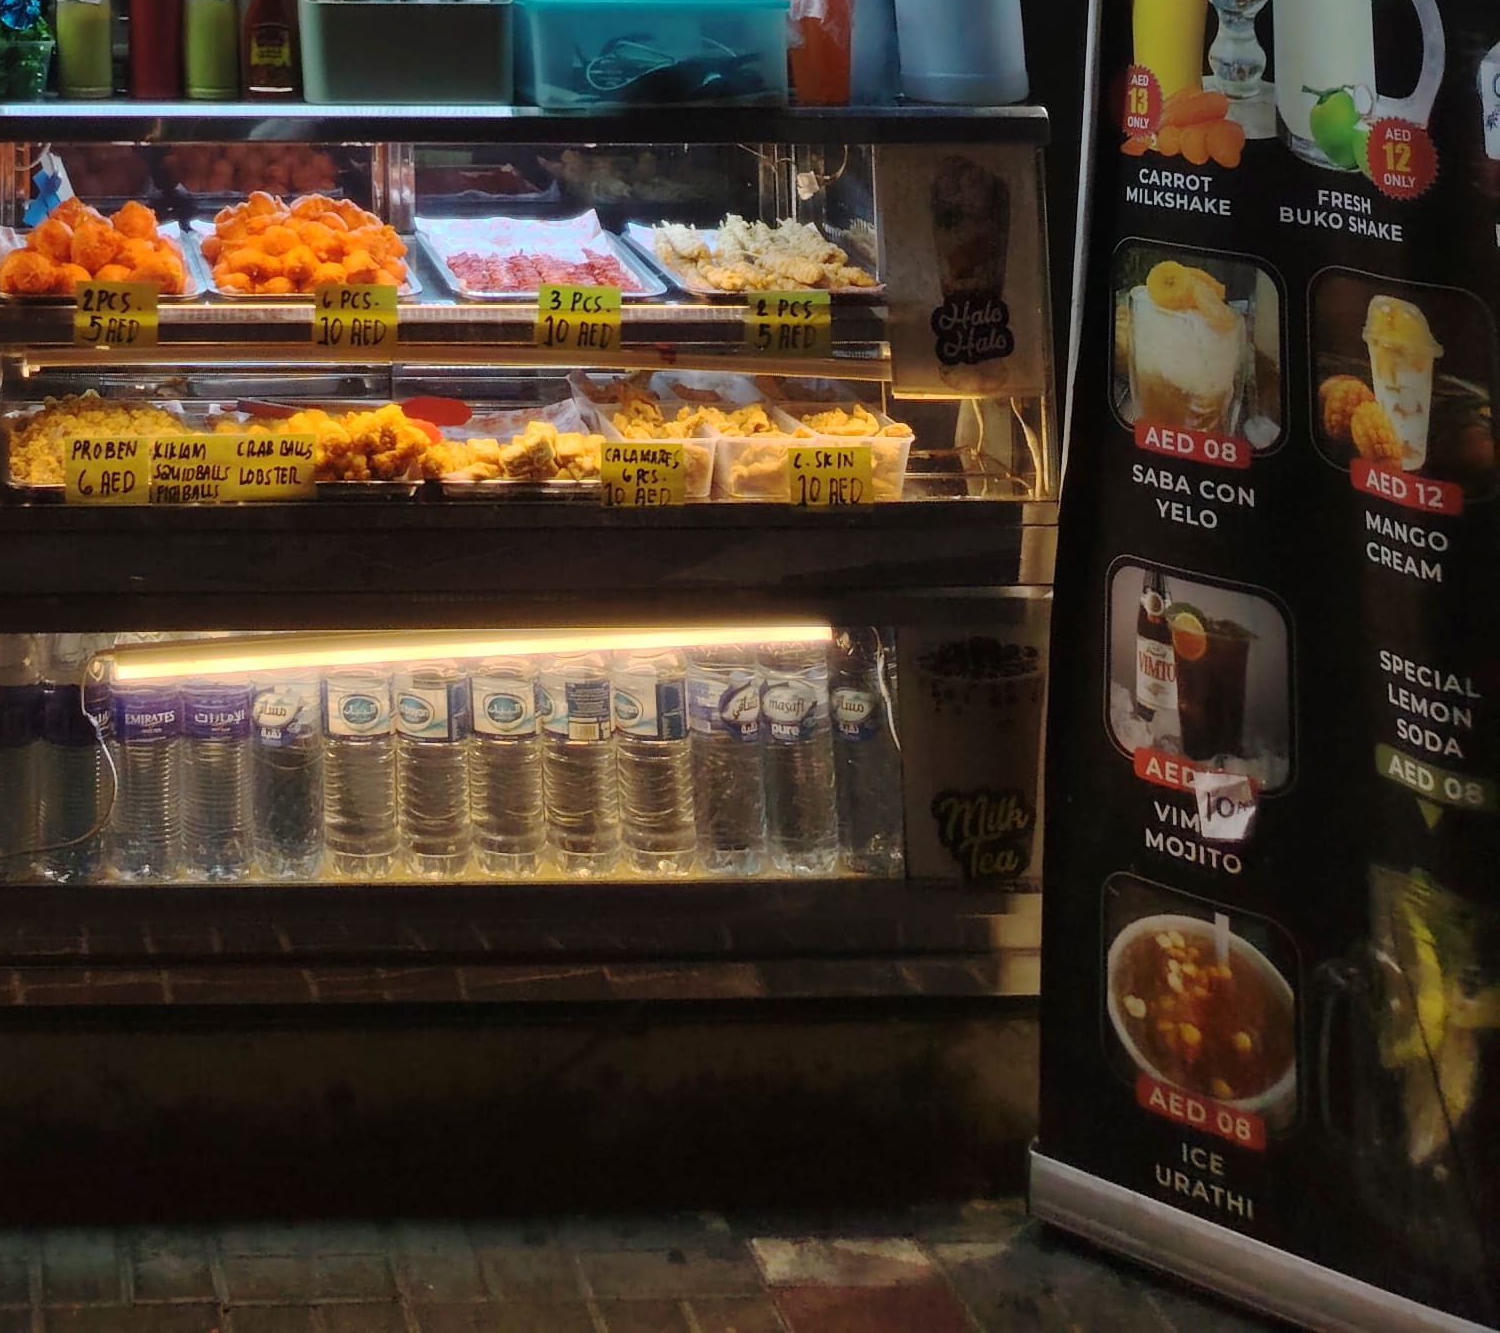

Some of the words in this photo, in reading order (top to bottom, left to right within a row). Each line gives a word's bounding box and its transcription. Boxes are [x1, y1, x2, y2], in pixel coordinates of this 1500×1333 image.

[1130, 74, 1149, 86] AED
[1128, 86, 1149, 115] 13
[1127, 115, 1150, 129] ONLY
[1384, 128, 1412, 143] AED
[1383, 144, 1412, 173] 12
[1138, 167, 1213, 194] CARROT
[1383, 173, 1416, 189] ONLY
[1125, 186, 1232, 217] MILKSHAKE
[1317, 189, 1372, 216] FRESH
[1278, 206, 1344, 231] BUKO
[1347, 215, 1404, 243] SHAKE
[550, 290, 561, 311] 3
[777, 299, 813, 318] PCS
[86, 317, 102, 341] 5
[104, 317, 141, 343] AED
[317, 316, 344, 346] 10
[348, 315, 388, 347] AED
[542, 315, 570, 346] 10
[577, 321, 613, 348] AED
[756, 323, 772, 349] 5
[778, 323, 817, 349] AED
[71, 440, 137, 461] PROBEN
[814, 451, 854, 468] SKIN
[1143, 426, 1195, 455] AED
[1203, 432, 1238, 464] 08
[77, 469, 94, 496] 6
[99, 468, 136, 495] AED
[239, 465, 302, 486] LOBSTER
[797, 475, 821, 507] 10
[828, 476, 864, 506] AED
[1130, 463, 1192, 496] SABA
[1198, 479, 1256, 508] CON
[1364, 467, 1408, 500] AED
[1414, 481, 1444, 509] 12
[603, 482, 626, 507] 10
[634, 487, 672, 507] AED
[1155, 498, 1219, 530] YELO
[1364, 509, 1449, 552] MANGO
[1364, 540, 1444, 584] CREAM
[1379, 650, 1482, 700] SPECIAL
[124, 710, 176, 726] EMIRATES
[1387, 683, 1472, 729] LEMON
[1396, 717, 1466, 759] SODA
[1388, 754, 1435, 792] AED
[1205, 791, 1235, 823] 10
[1144, 828, 1243, 875] MOJITO
[1148, 1087, 1206, 1124] AED
[1217, 1112, 1252, 1141] 08
[1181, 1141, 1226, 1176] ICE
[1154, 1163, 1255, 1221] URATHI
